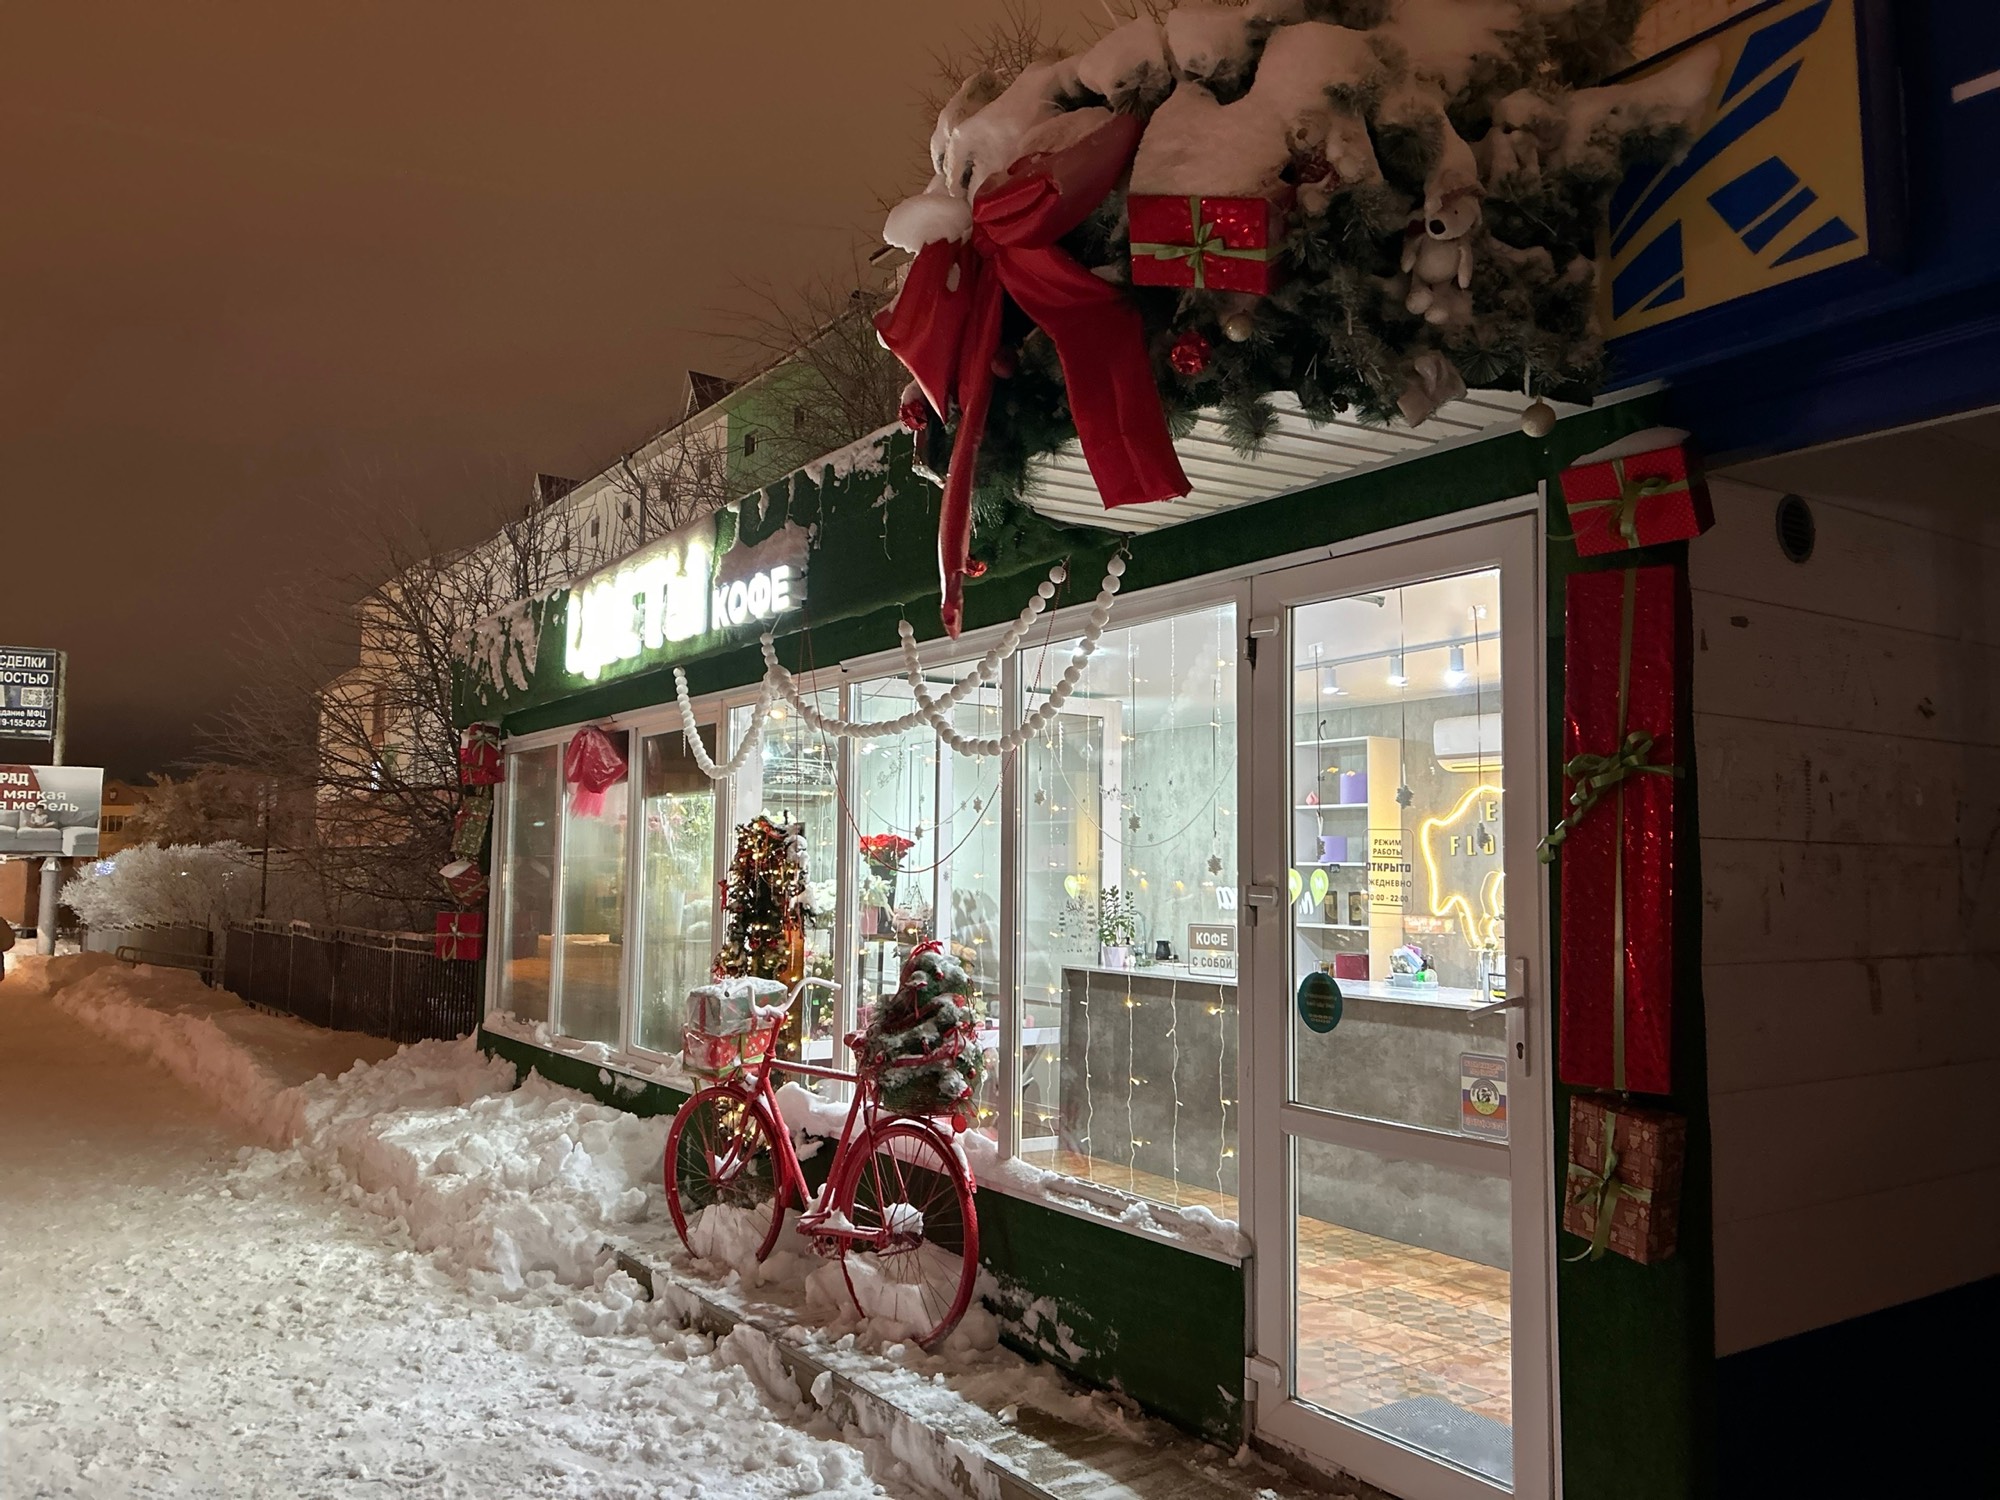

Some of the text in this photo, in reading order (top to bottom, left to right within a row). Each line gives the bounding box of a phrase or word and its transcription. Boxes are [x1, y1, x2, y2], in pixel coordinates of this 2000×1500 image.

[711, 563, 791, 631] КОФЕ
[0, 709, 46, 719] дание МФЦ
[0, 718, 47, 728] 9-155-02-57
[3, 789, 66, 801] мягкая
[12, 799, 79, 812] мебель
[1374, 838, 1402, 846] РЕЖИМ
[1372, 848, 1403, 856] РАБОТЫ
[1366, 862, 1411, 873] ОТКРЫТО
[1364, 878, 1412, 888] ЖЕДНЕВНО
[1195, 932, 1228, 946] КОФЕ
[1192, 956, 1232, 969] С СОБОЙ
